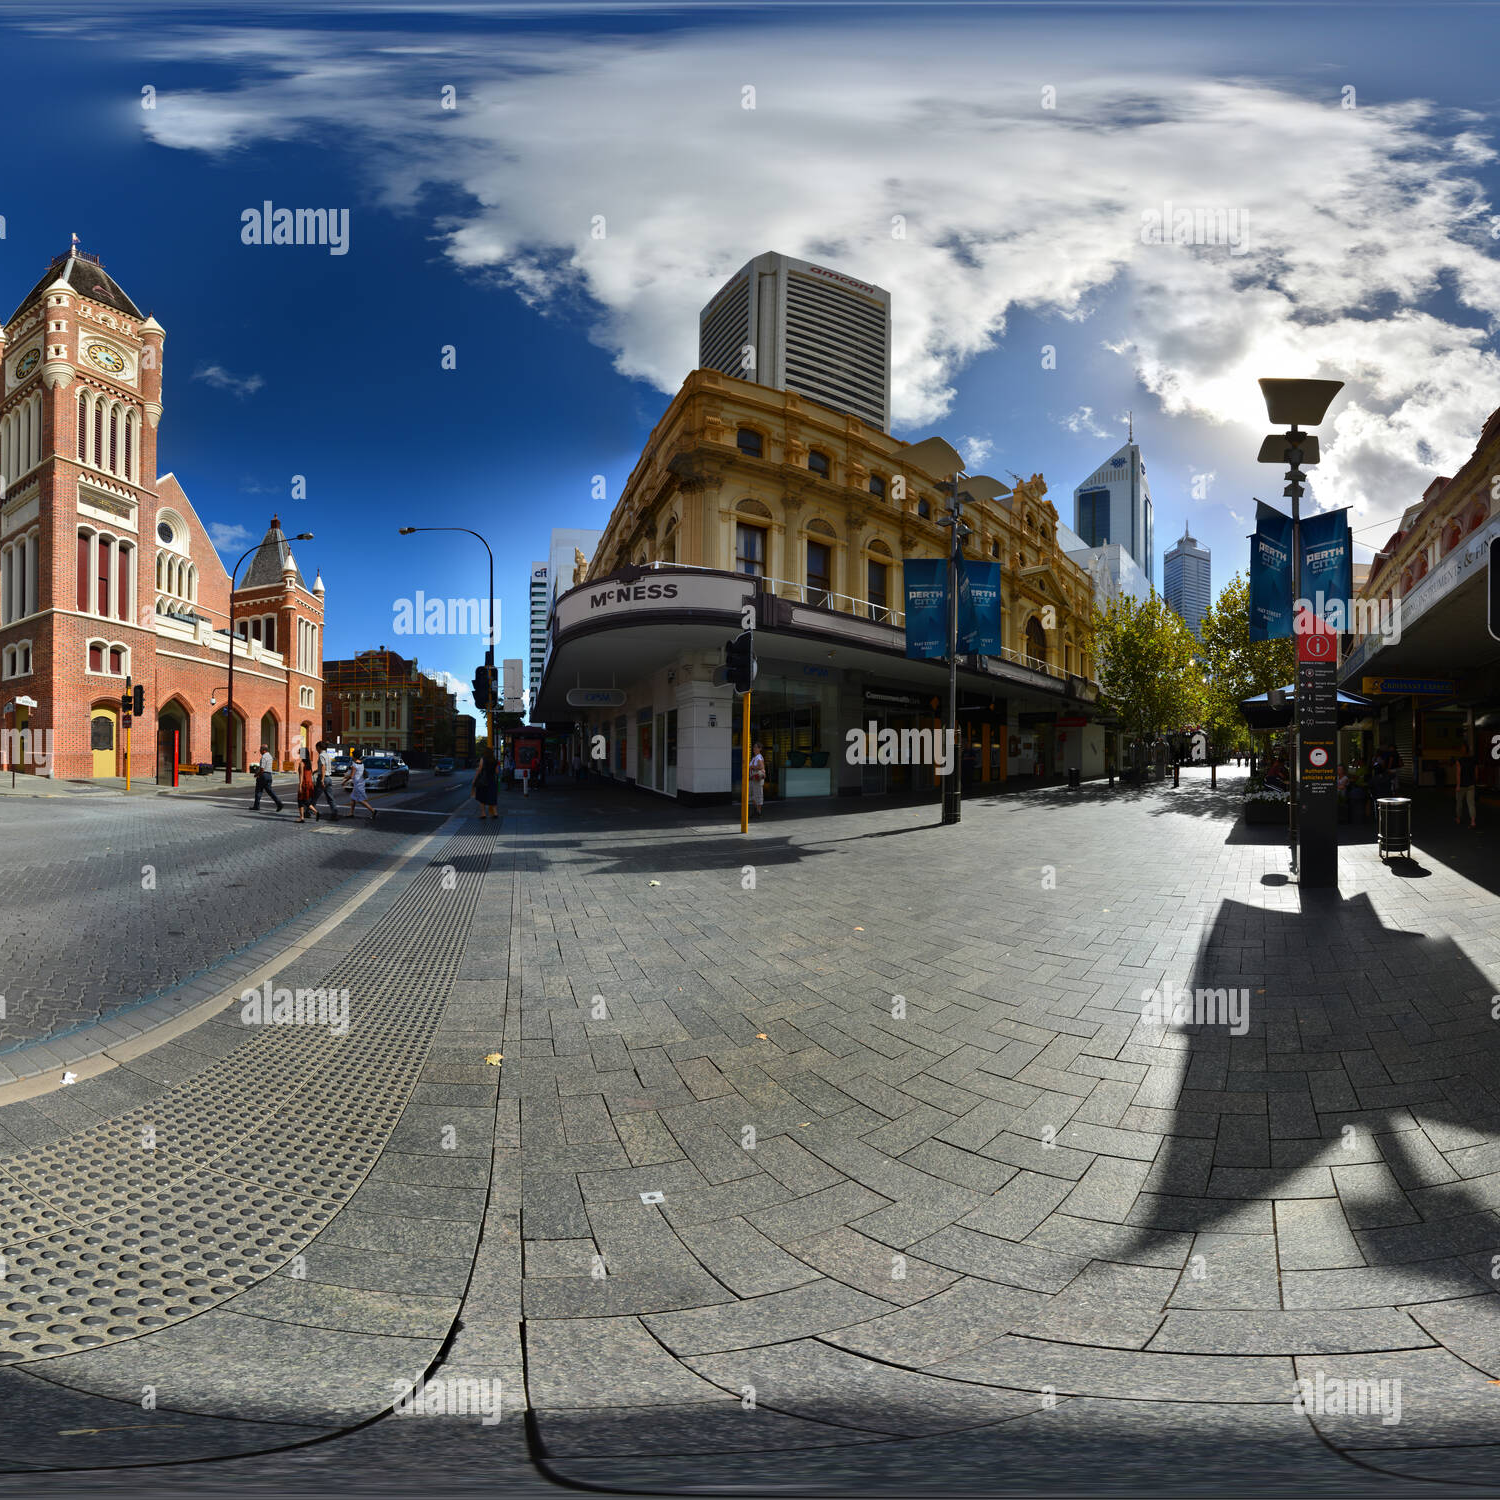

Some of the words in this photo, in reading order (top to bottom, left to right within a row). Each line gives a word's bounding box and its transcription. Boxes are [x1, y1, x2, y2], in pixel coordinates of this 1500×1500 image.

[810, 266, 874, 294] amcom
[1259, 541, 1287, 562] PERTH
[1306, 546, 1344, 566] PERTH
[1262, 552, 1281, 566] CITY
[1312, 556, 1337, 569] CITY
[909, 591, 943, 600] PERTH
[970, 589, 996, 598] ERTH
